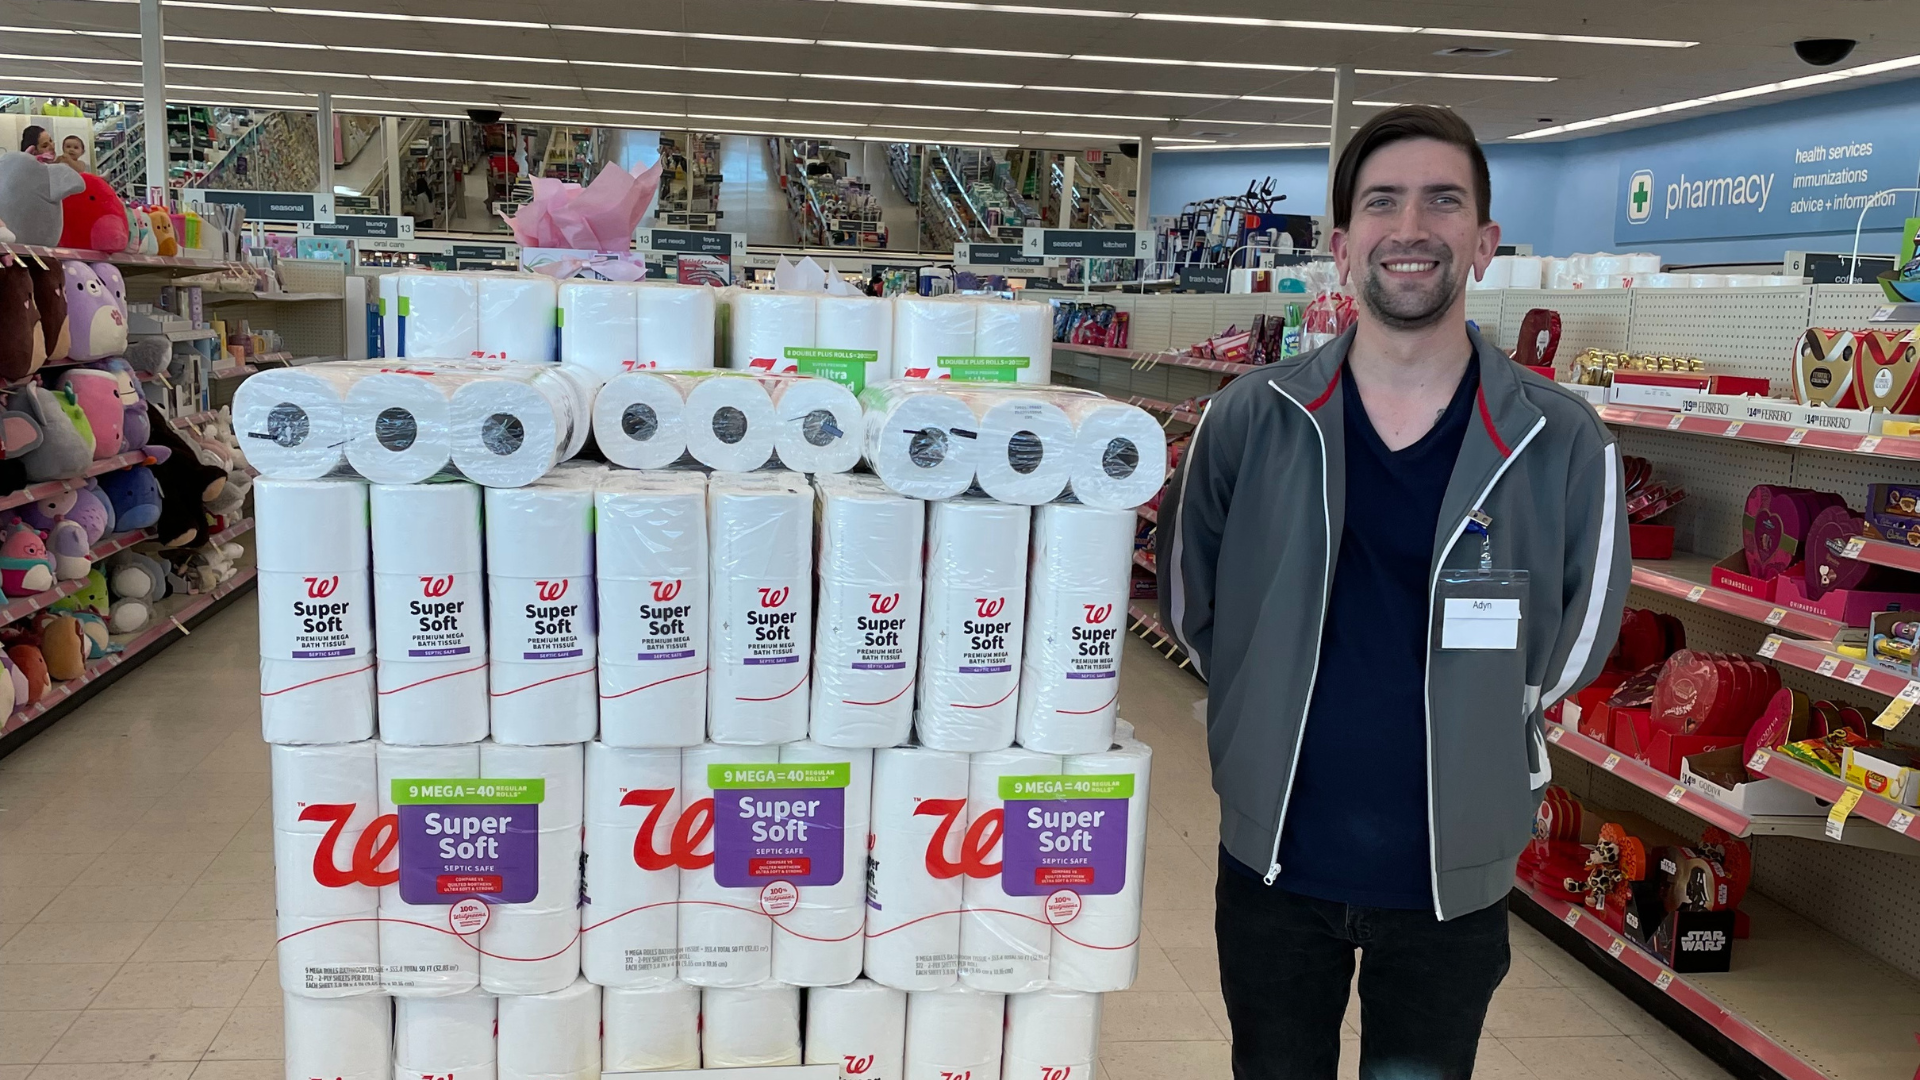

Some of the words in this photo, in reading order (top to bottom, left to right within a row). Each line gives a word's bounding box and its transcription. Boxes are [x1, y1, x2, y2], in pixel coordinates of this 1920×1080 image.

[1795, 147, 1826, 164] health
[1829, 141, 1872, 160] services
[1793, 167, 1868, 188] immunizations
[1666, 173, 1774, 219] pharmacy
[1791, 196, 1823, 214] advice
[1833, 190, 1896, 210] information
[320, 204, 327, 214] 4
[1031, 239, 1037, 247] 4
[1141, 241, 1147, 250] 5
[1793, 261, 1799, 270] 6
[1189, 275, 1205, 283] trash
[1207, 276, 1223, 285] bags
[1698, 401, 1729, 415] FERRERO
[1761, 409, 1792, 422] FERRERO
[1820, 416, 1851, 429] FERRERO
[1721, 577, 1753, 592] GHIRARDELLI
[294, 601, 349, 618] Super
[410, 601, 464, 617] Super
[526, 605, 578, 620] Super
[640, 605, 690, 621] Super
[1473, 601, 1492, 611] Adyn
[1790, 601, 1827, 616] GHIRARDELLI
[304, 618, 342, 633] Soft
[420, 616, 458, 631] Soft
[535, 619, 571, 634] Soft
[747, 612, 797, 627] Super
[857, 617, 906, 631] Super
[649, 620, 684, 635] Soft
[756, 626, 790, 641] Soft
[964, 621, 1011, 635] Super
[1072, 627, 1117, 642] Super
[865, 633, 898, 646] Soft
[971, 636, 1004, 650] Soft
[1078, 642, 1110, 656] Soft
[724, 771, 732, 782] 9
[410, 787, 418, 798] 9
[1014, 783, 1023, 793] 9
[1699, 781, 1721, 796] GODIVA
[739, 797, 820, 821] Super
[425, 813, 512, 840] Super
[1028, 807, 1104, 832] Super
[752, 820, 808, 842] Soft
[440, 837, 498, 860] Soft
[1039, 832, 1092, 852] Soft
[1681, 931, 1726, 941] STAR
[1681, 940, 1726, 951] WARS
